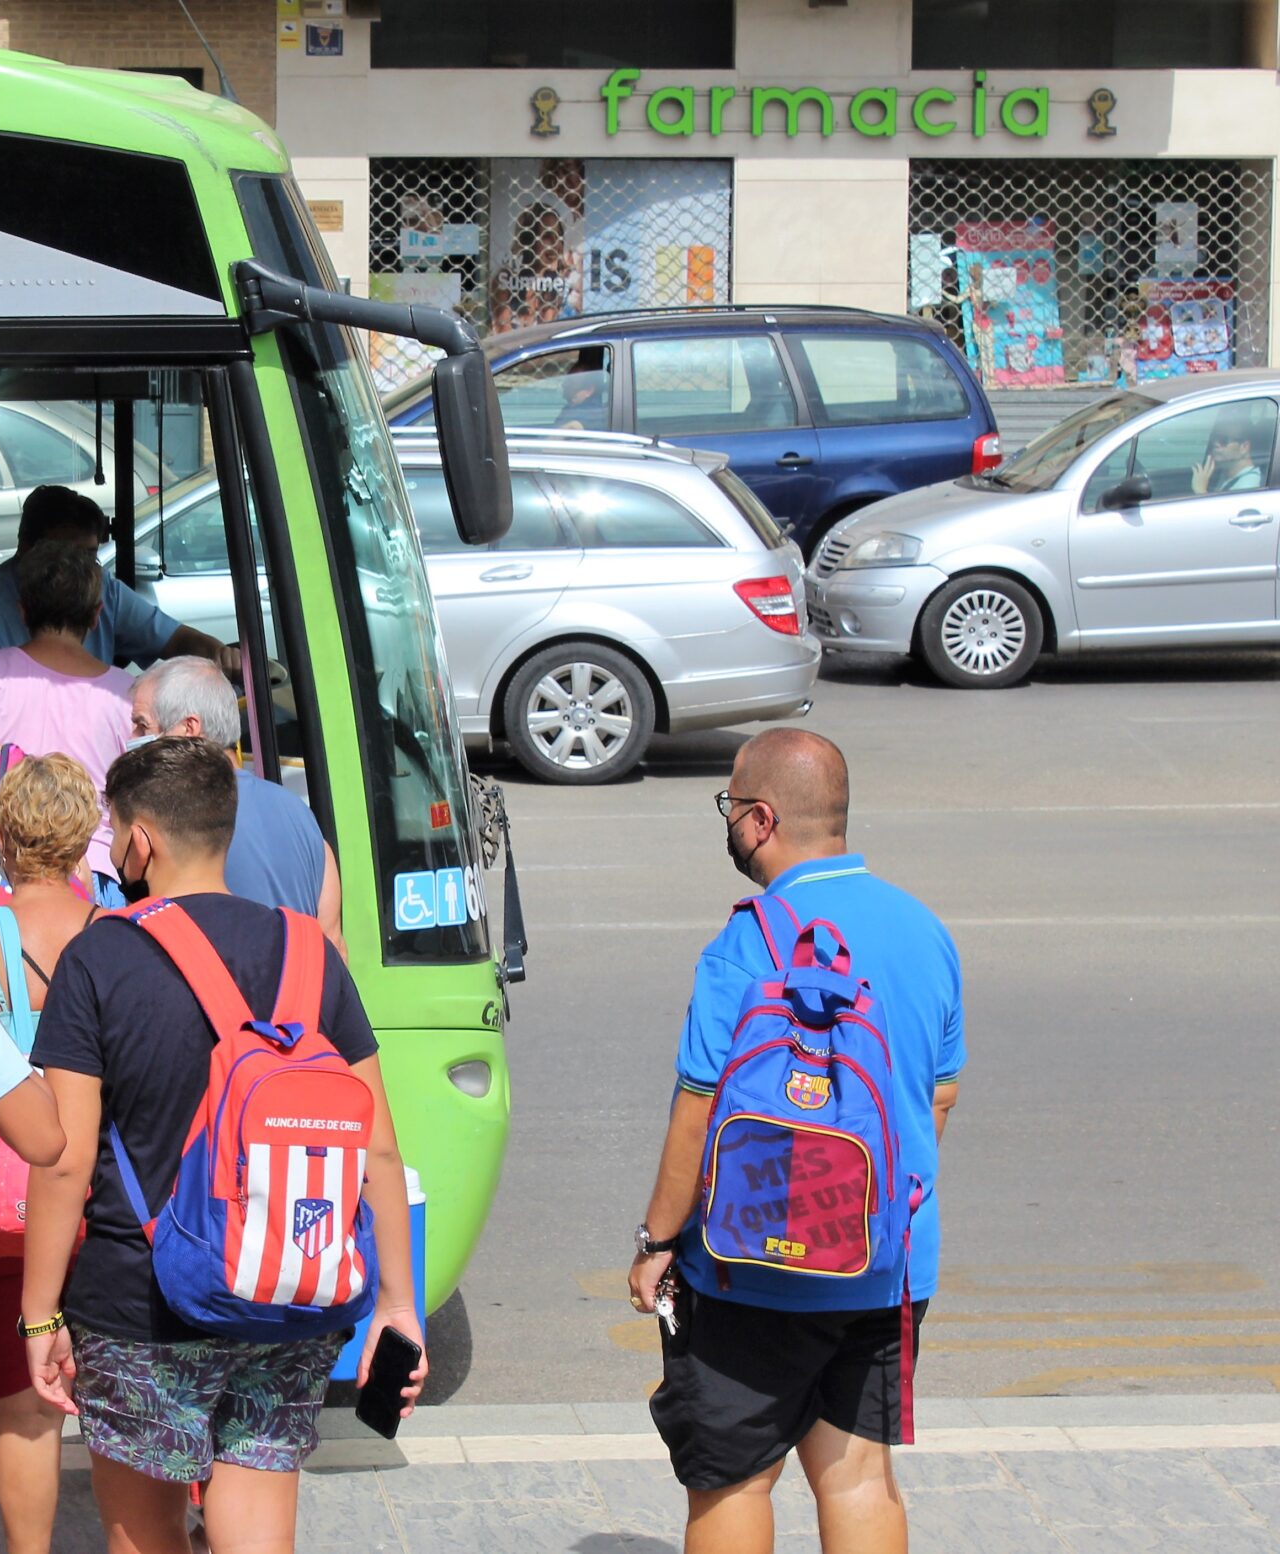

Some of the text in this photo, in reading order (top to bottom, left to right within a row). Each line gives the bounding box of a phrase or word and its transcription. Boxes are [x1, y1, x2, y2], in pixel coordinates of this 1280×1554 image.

[600, 67, 1049, 137] farmacia
[265, 1117, 362, 1131] NUNCA DEJES DE CREER
[739, 1178, 865, 1233] QUE UN
[765, 1237, 807, 1257] FCB
